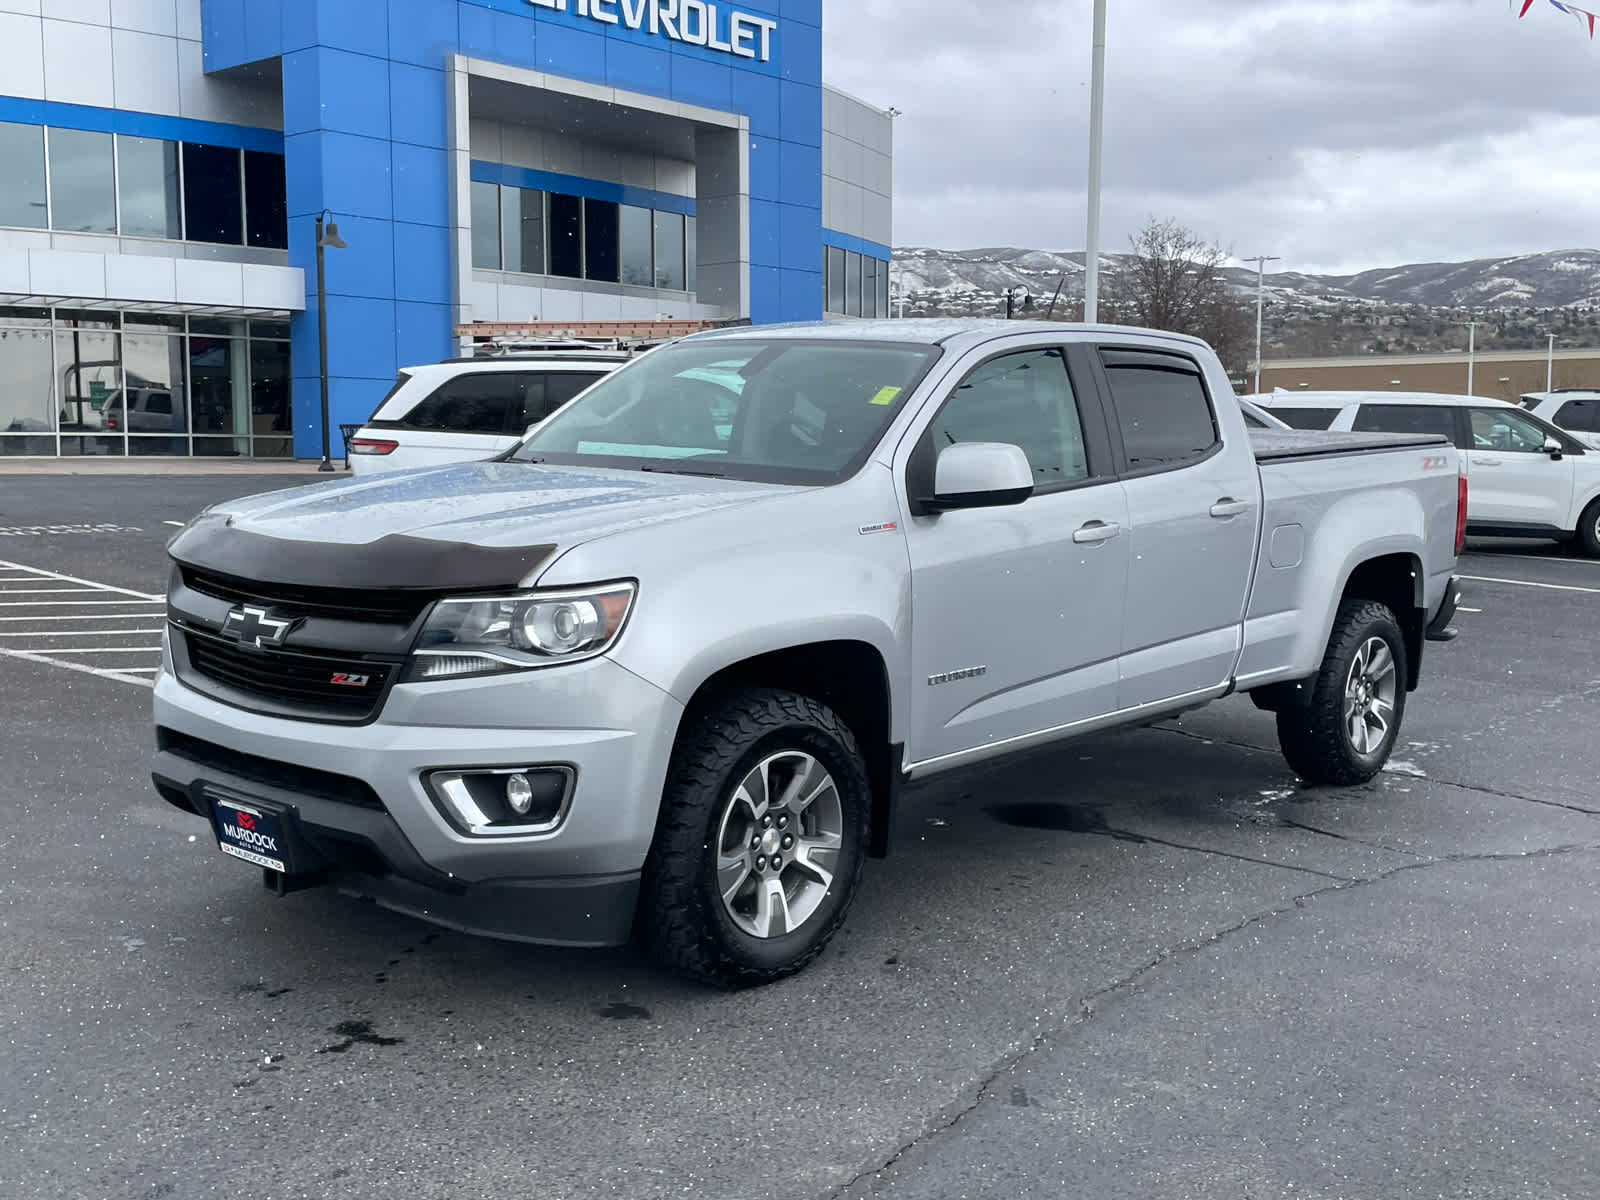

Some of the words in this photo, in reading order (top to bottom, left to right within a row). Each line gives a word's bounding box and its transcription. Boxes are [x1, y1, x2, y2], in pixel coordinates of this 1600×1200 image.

[529, 0, 776, 61] EVROLET
[330, 672, 369, 687] Z71
[223, 822, 277, 851] MURDOCK
